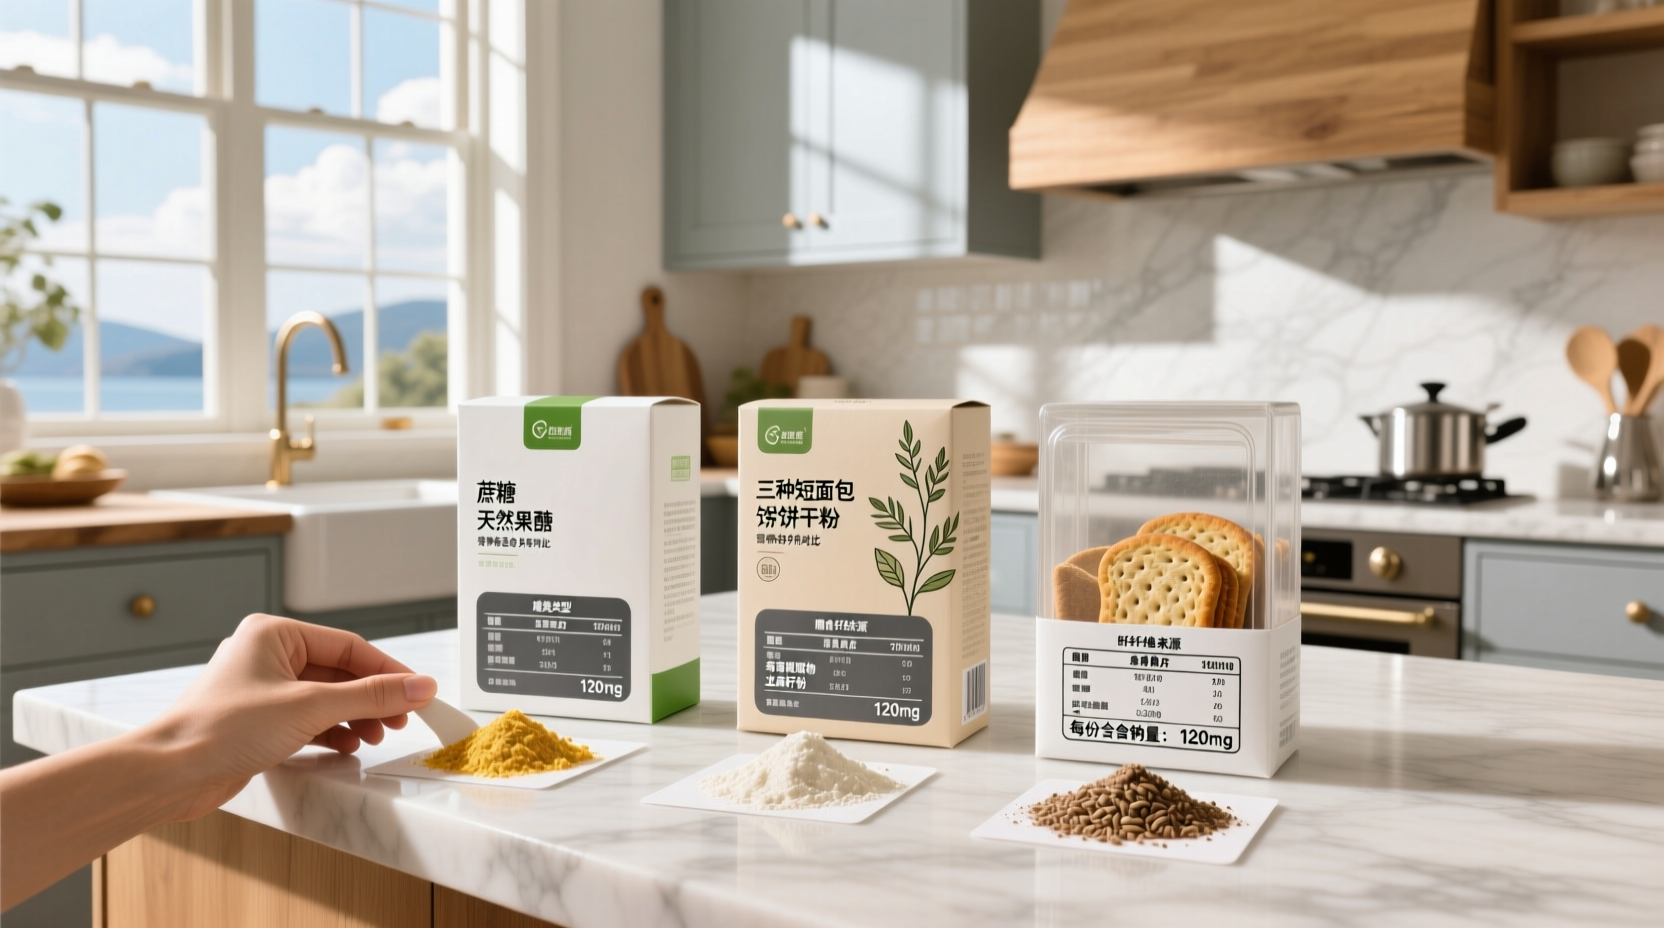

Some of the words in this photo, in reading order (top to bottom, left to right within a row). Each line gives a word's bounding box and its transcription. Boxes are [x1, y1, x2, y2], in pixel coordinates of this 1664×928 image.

[756, 478, 854, 501] 三种短面包
[874, 702, 920, 721] 120mg
[1180, 729, 1233, 750] 120mg
